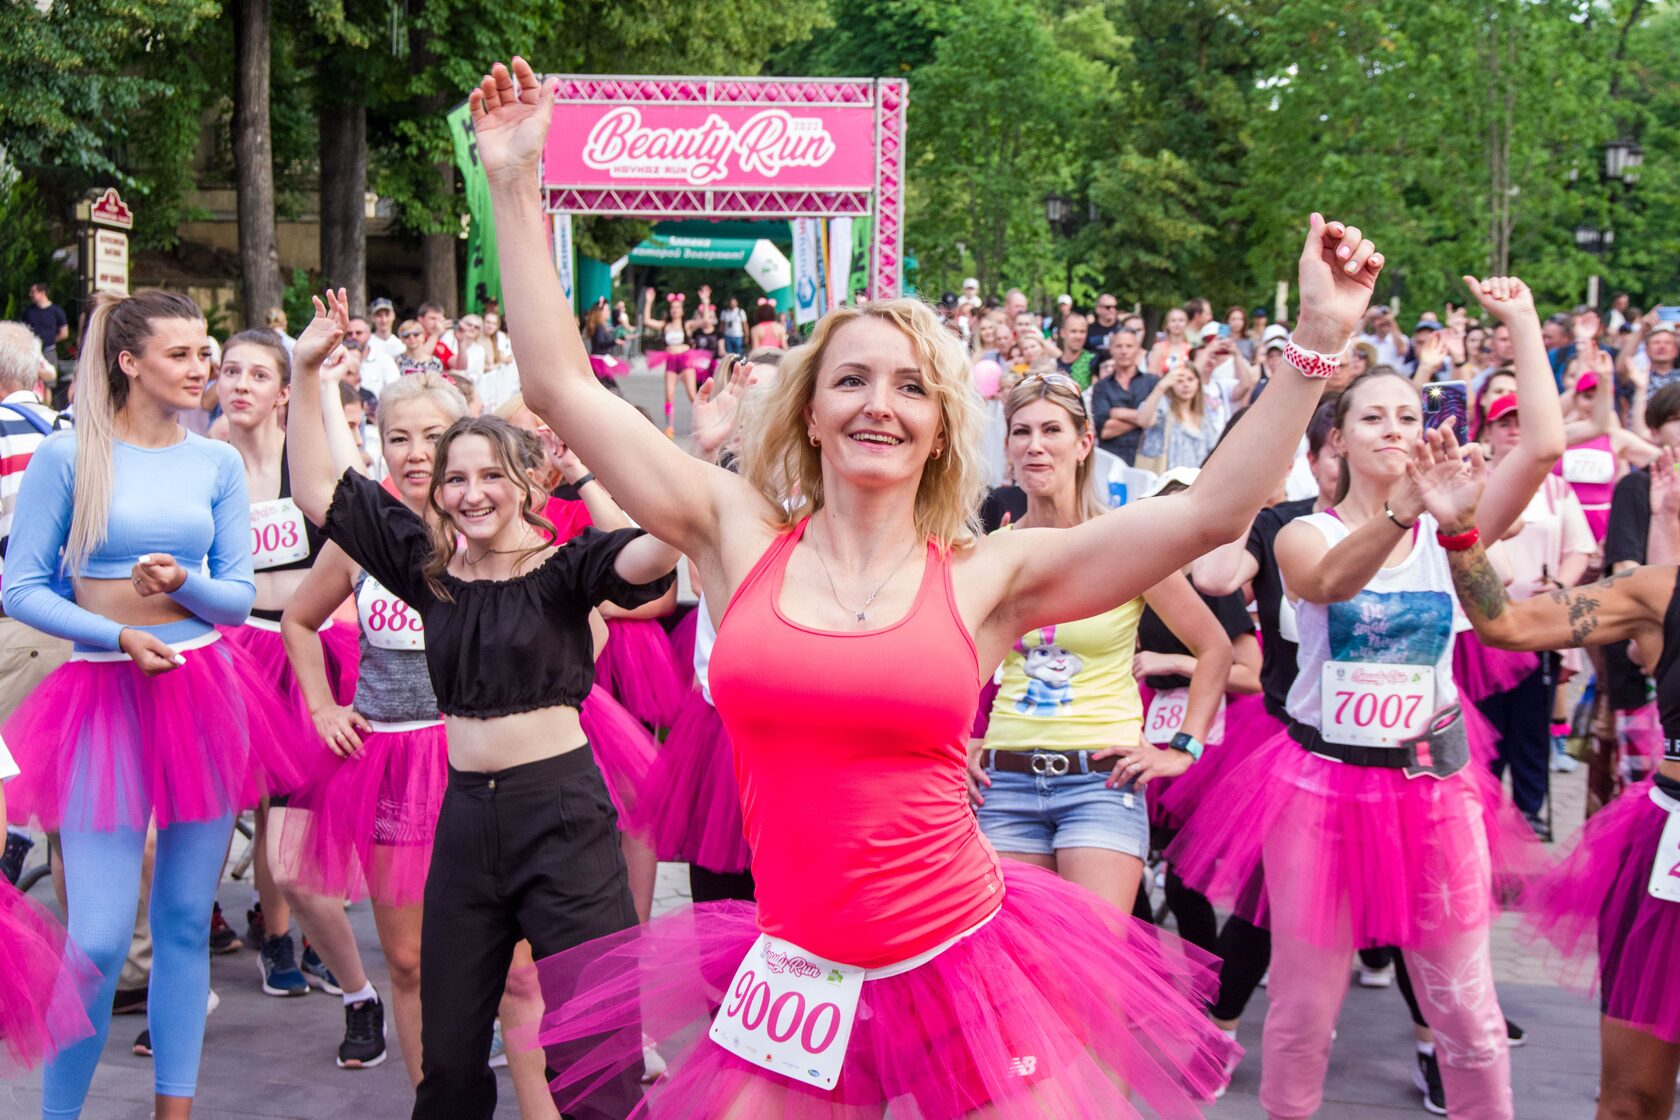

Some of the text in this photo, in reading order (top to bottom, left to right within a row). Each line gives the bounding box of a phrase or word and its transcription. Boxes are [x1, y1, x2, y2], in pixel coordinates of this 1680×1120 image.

[583, 107, 835, 184] Beauty Run
[1334, 690, 1424, 729] 7007
[787, 956, 821, 979] Run
[727, 970, 841, 1054] 9000
